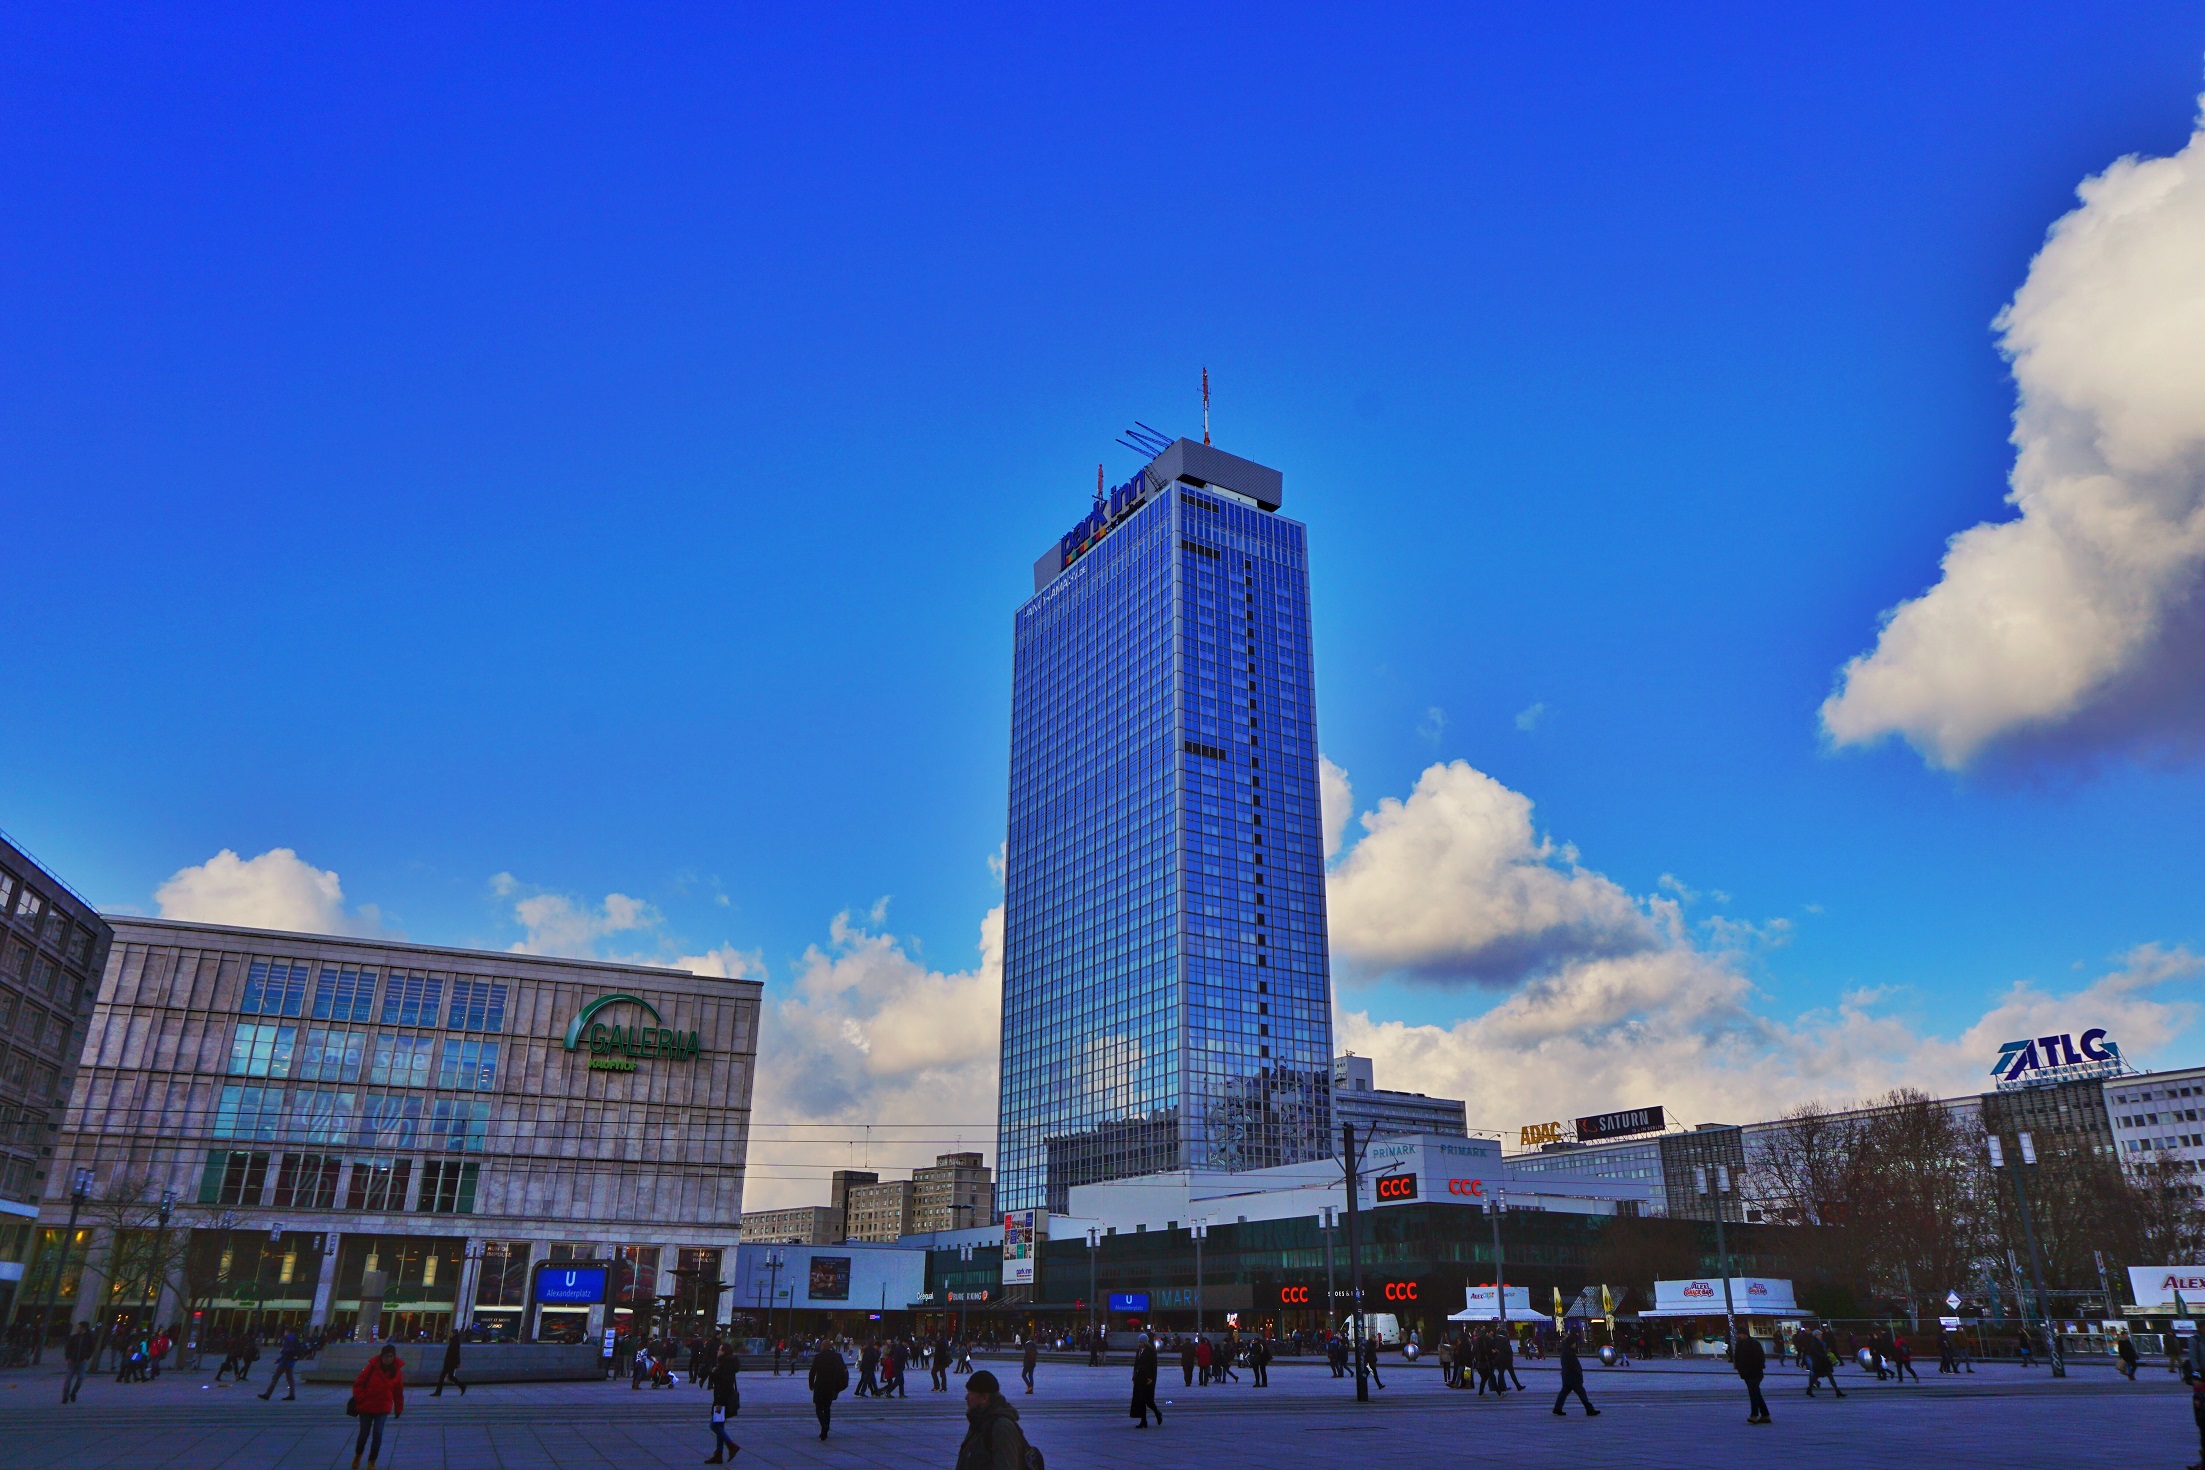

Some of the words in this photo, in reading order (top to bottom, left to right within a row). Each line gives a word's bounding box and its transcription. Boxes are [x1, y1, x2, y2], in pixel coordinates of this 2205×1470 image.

[1061, 500, 1107, 571] park
[1110, 468, 1145, 518] inn
[589, 1023, 700, 1060] GALERIA
[380, 1046, 425, 1070] sale
[588, 1059, 638, 1071] KAUFHOF
[1599, 1111, 1649, 1132] SATURN
[1521, 1121, 1562, 1145] ADAC
[1373, 1144, 1416, 1158] PRIMARK
[1440, 1144, 1488, 1157] PRIMARK
[1381, 1178, 1411, 1197] CCC
[1449, 1178, 1482, 1196] CCC
[566, 1271, 576, 1287] U
[546, 1289, 592, 1299] Alexanderplatz
[952, 1292, 970, 1301] BURGR
[1125, 1294, 1133, 1304] U
[1281, 1287, 1308, 1303] CCC
[1384, 1281, 1418, 1300] CCC
